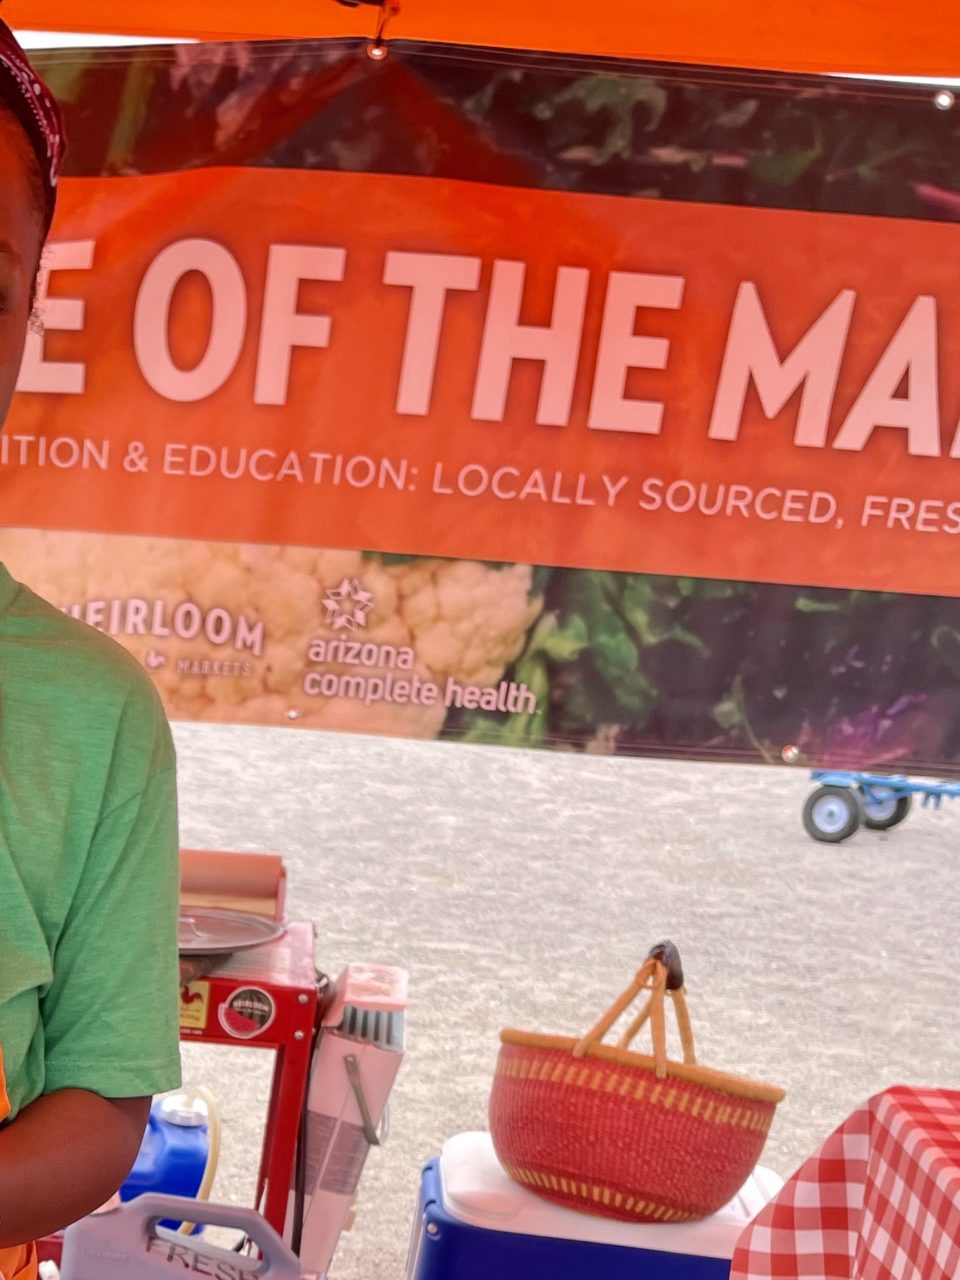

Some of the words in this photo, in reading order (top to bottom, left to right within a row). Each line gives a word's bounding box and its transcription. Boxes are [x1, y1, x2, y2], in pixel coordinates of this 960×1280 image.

[132, 237, 347, 406] OF
[383, 250, 685, 435] THE
[707, 280, 960, 459] MA
[122, 440, 149, 473] &
[162, 442, 419, 492] EDUCATION:
[432, 461, 629, 508] LOCALLY
[638, 477, 844, 530] SOURCED,
[176, 658, 252, 677] MARKETS
[307, 634, 415, 670] arizona
[303, 671, 439, 706] complete
[443, 676, 538, 715] health
